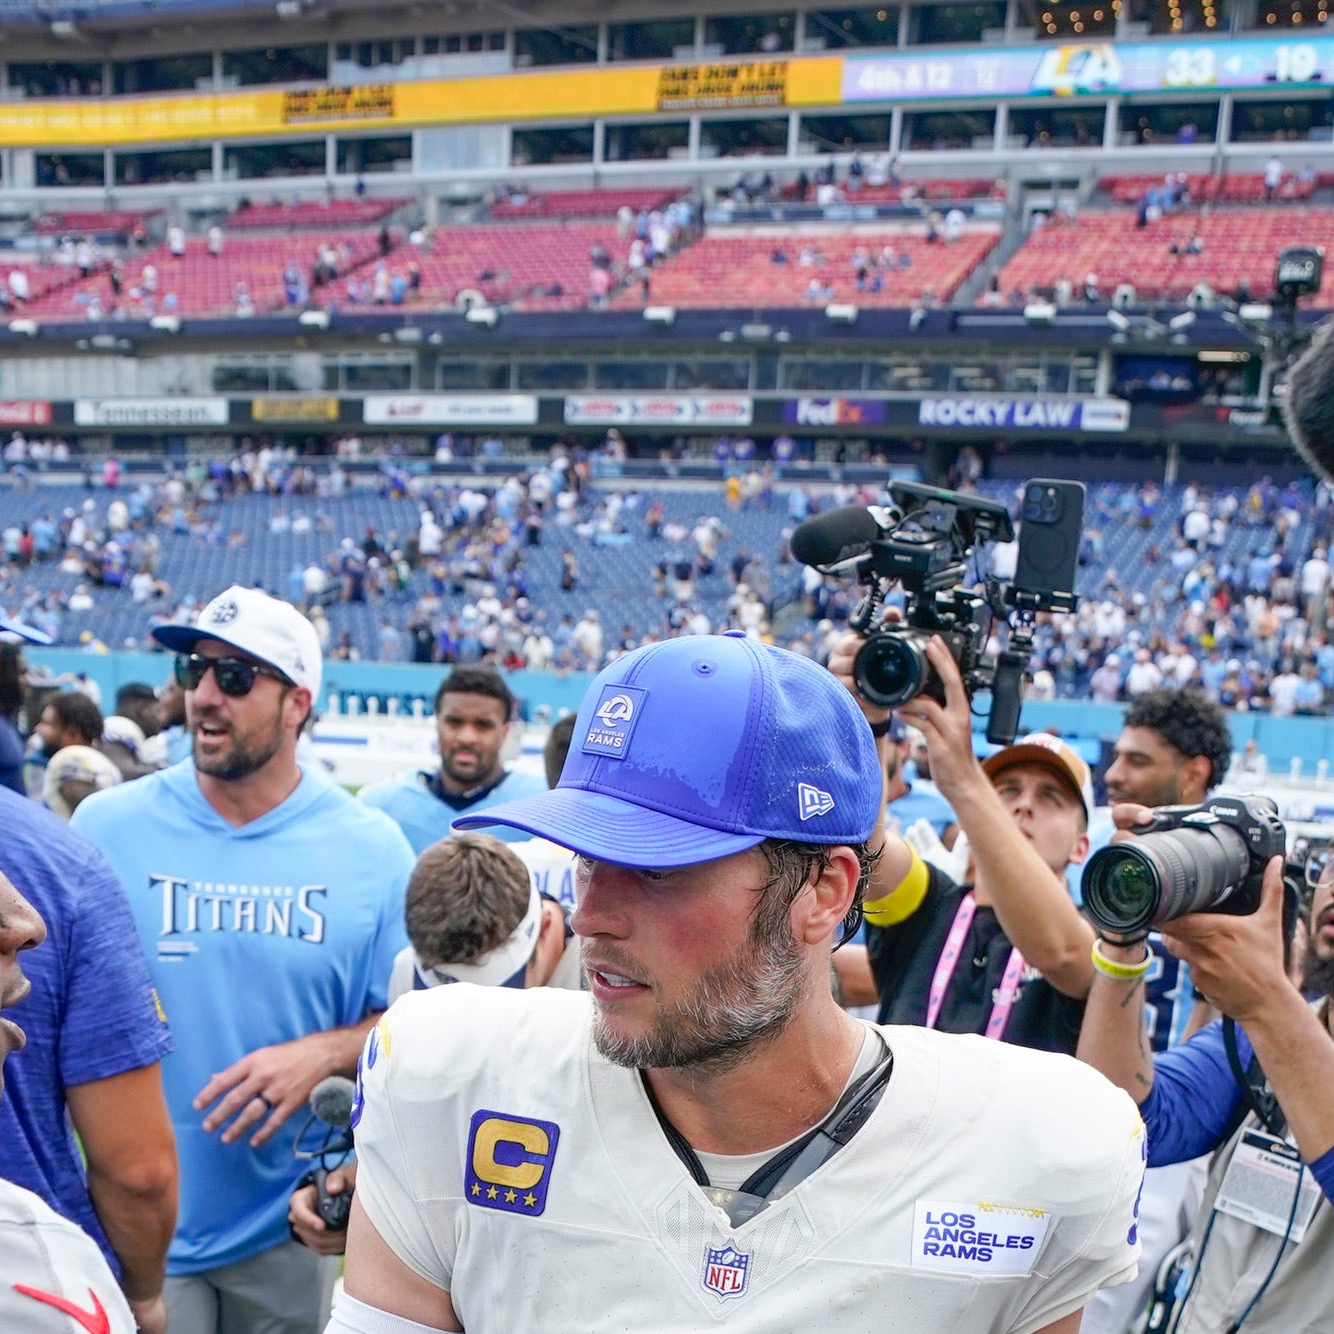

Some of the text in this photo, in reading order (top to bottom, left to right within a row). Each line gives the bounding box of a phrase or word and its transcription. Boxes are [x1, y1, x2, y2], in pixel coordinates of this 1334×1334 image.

[1166, 48, 1215, 84] 33
[795, 399, 862, 425] FedEx
[918, 399, 1078, 427] ROCKY LAW
[587, 733, 623, 748] RAMS
[1209, 804, 1239, 817] Canon
[148, 872, 328, 946] TITANS
[471, 1118, 550, 1190] C
[925, 1211, 976, 1229] LOS
[923, 1226, 1035, 1250] ANGELES
[923, 1241, 994, 1262] RAMS
[708, 1265, 741, 1291] NFL
